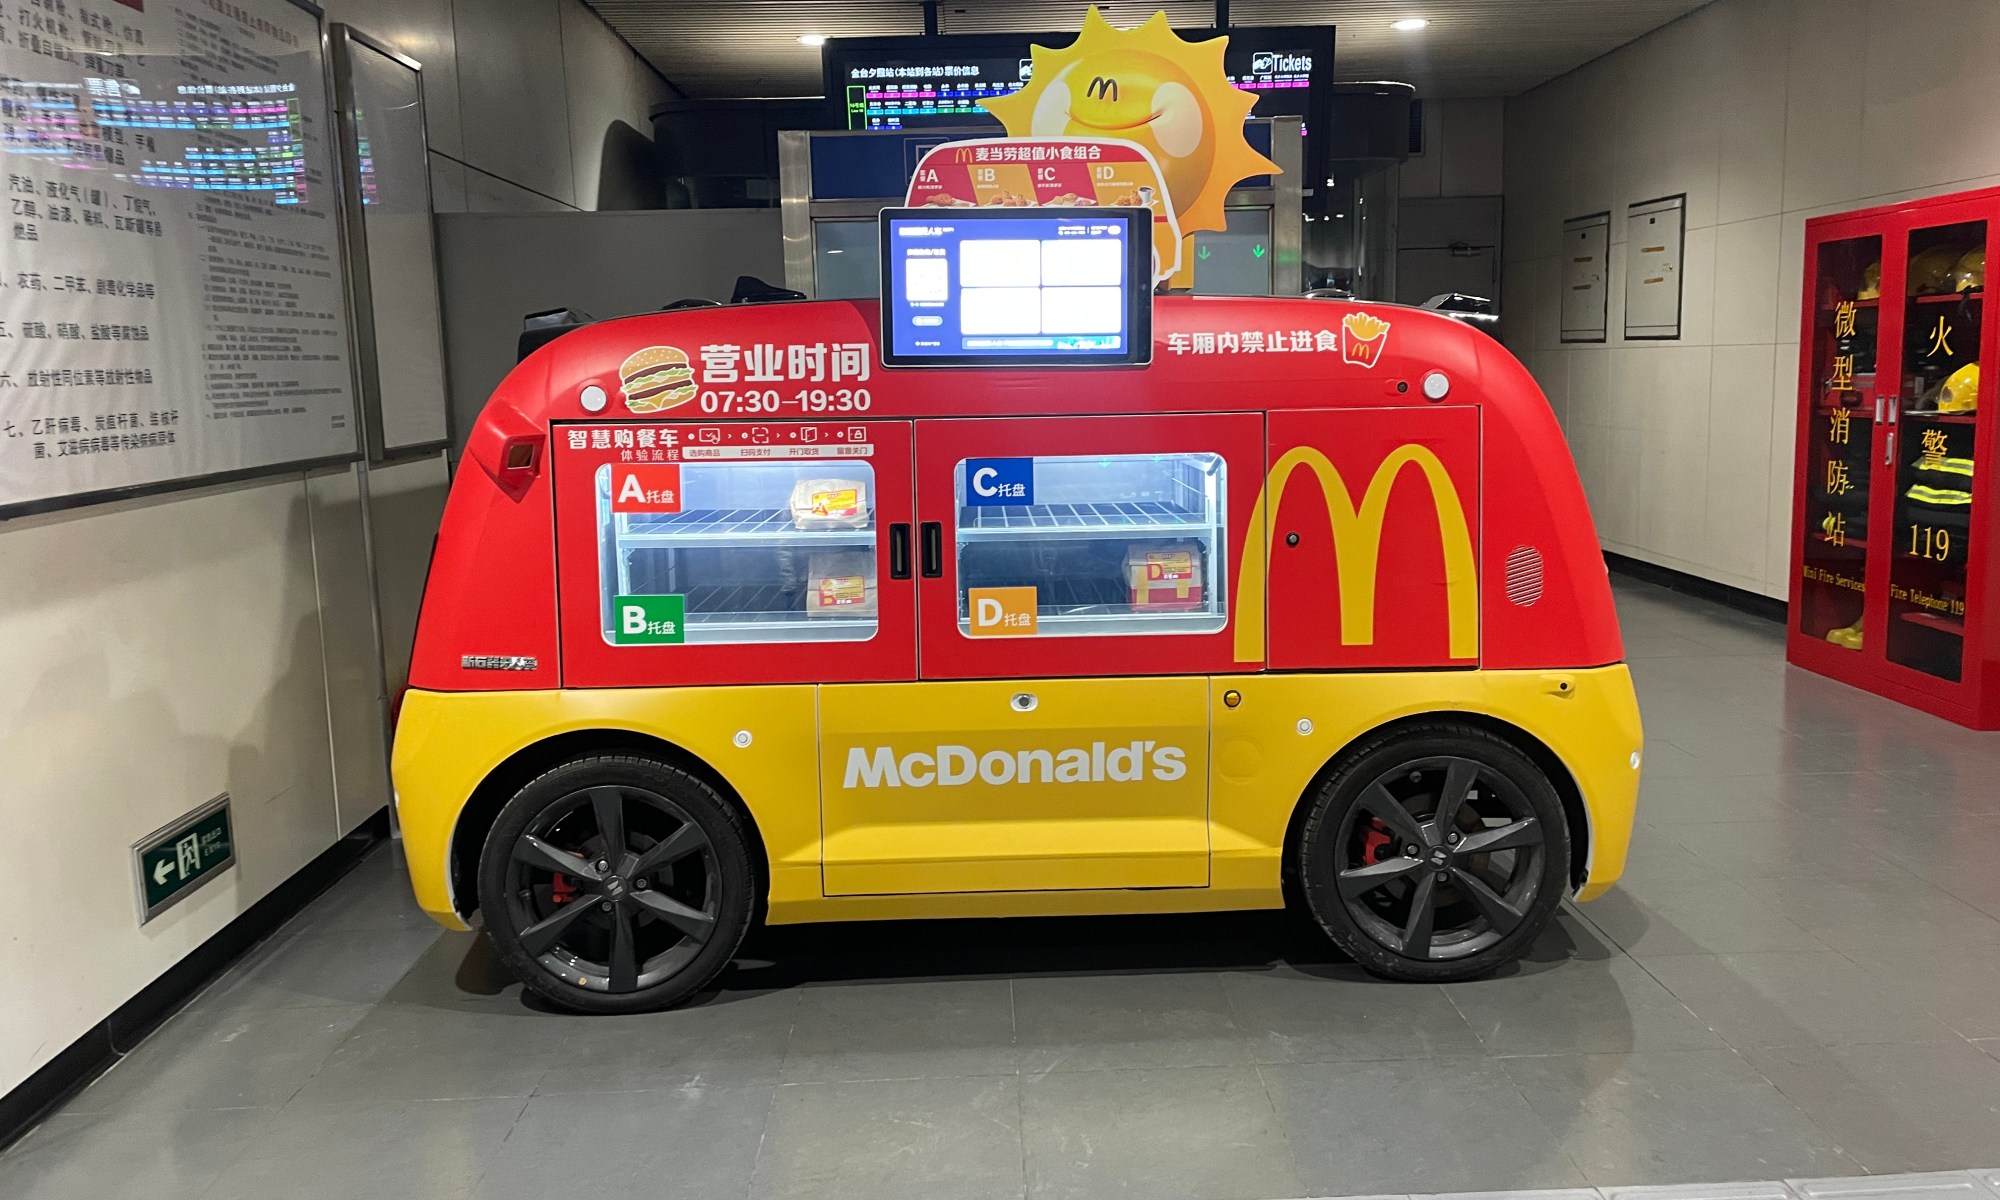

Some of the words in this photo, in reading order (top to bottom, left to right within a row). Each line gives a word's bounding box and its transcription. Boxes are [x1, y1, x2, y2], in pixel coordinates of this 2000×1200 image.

[1272, 54, 1312, 72] Tickets
[975, 145, 1101, 161] 麦当劳超值小食组合
[984, 168, 996, 182] B
[1044, 167, 1056, 181] C
[1103, 166, 1114, 180] D
[1167, 330, 1338, 356] 车厢内禁止进食
[700, 343, 870, 383] 营业时间
[567, 428, 679, 449] 智慧购餐车
[620, 449, 679, 462] 体验流程
[740, 448, 771, 456] 扫码支付
[789, 447, 819, 456] 开门取货
[1909, 524, 1949, 561] 119
[1803, 565, 1817, 580] Mini
[1819, 569, 1834, 584] Fire
[1835, 573, 1865, 593] Services
[1890, 583, 1907, 601] Fire
[1910, 588, 1948, 611] Telephone
[1950, 600, 1964, 616] 119
[843, 740, 1187, 789] McDonald's
